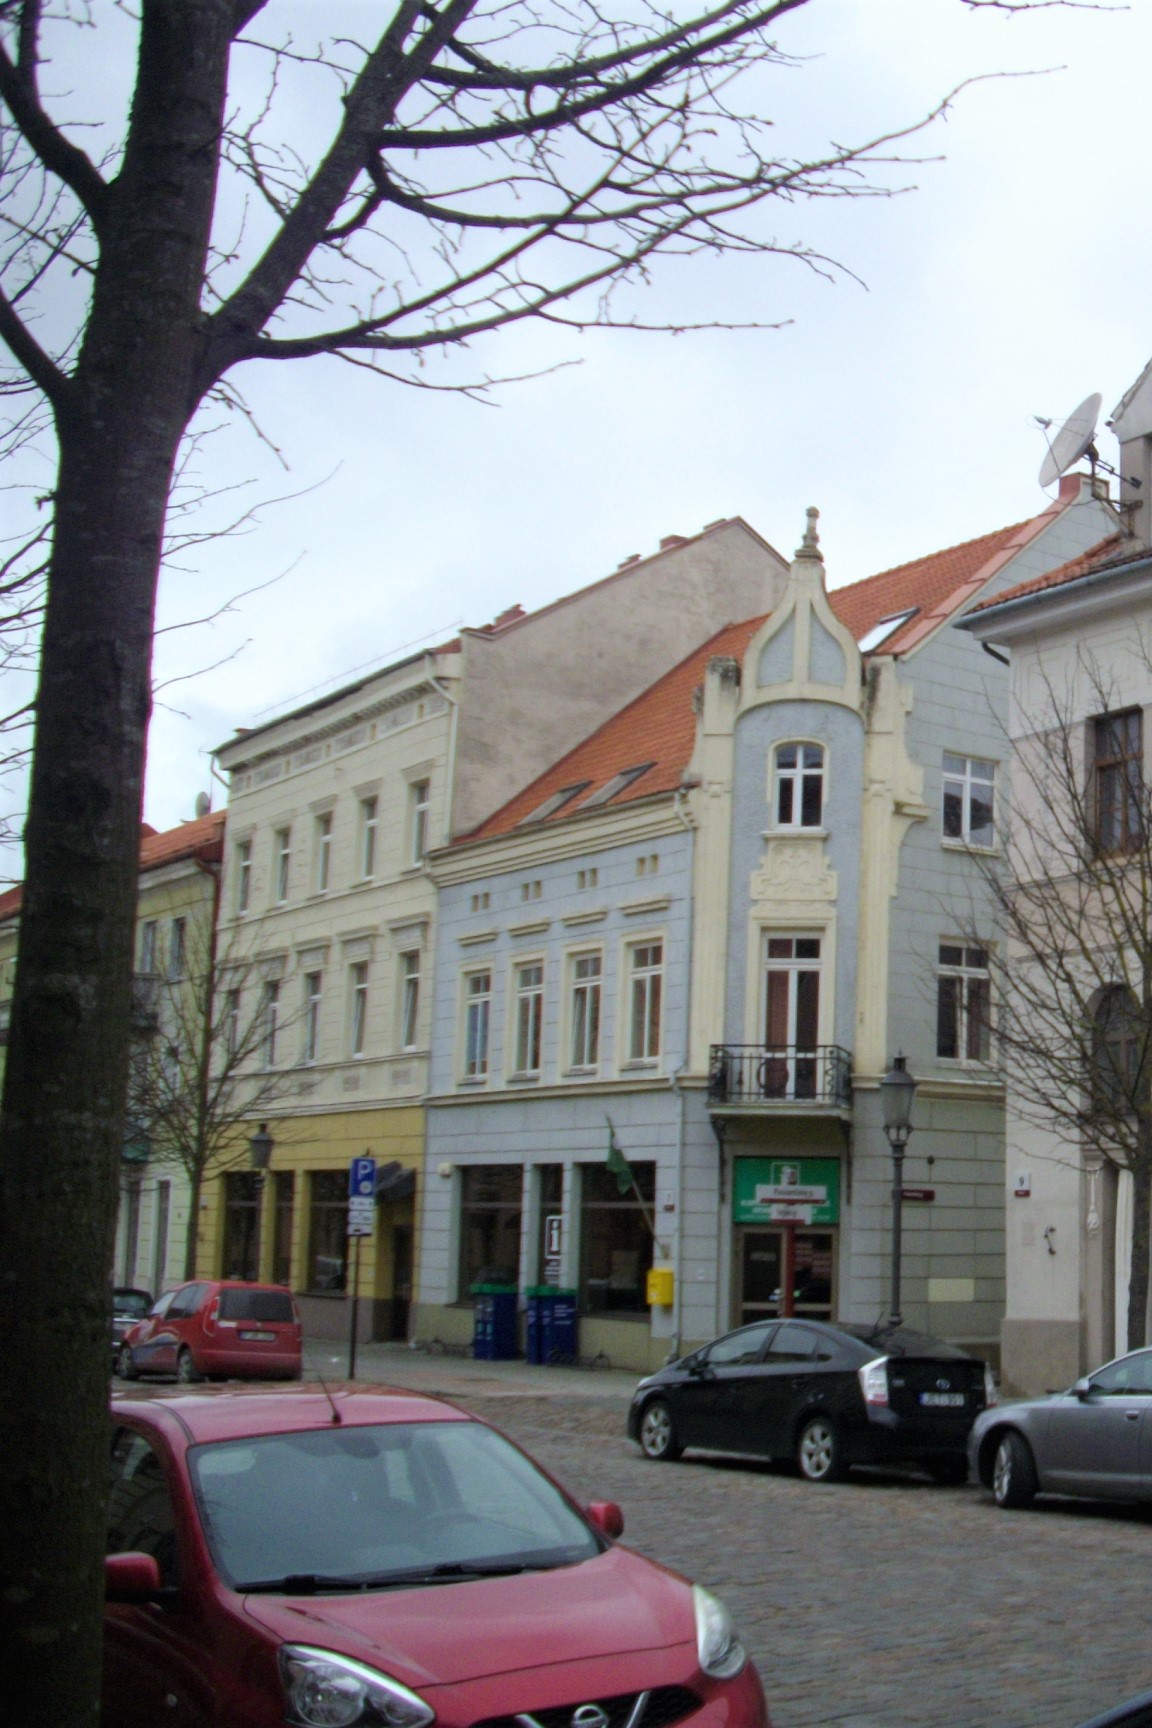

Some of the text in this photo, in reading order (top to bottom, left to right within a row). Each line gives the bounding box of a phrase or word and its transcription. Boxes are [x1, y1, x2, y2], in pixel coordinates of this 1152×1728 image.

[357, 1161, 372, 1180] P
[1018, 1176, 1025, 1187] 9
[550, 1220, 560, 1252] i
